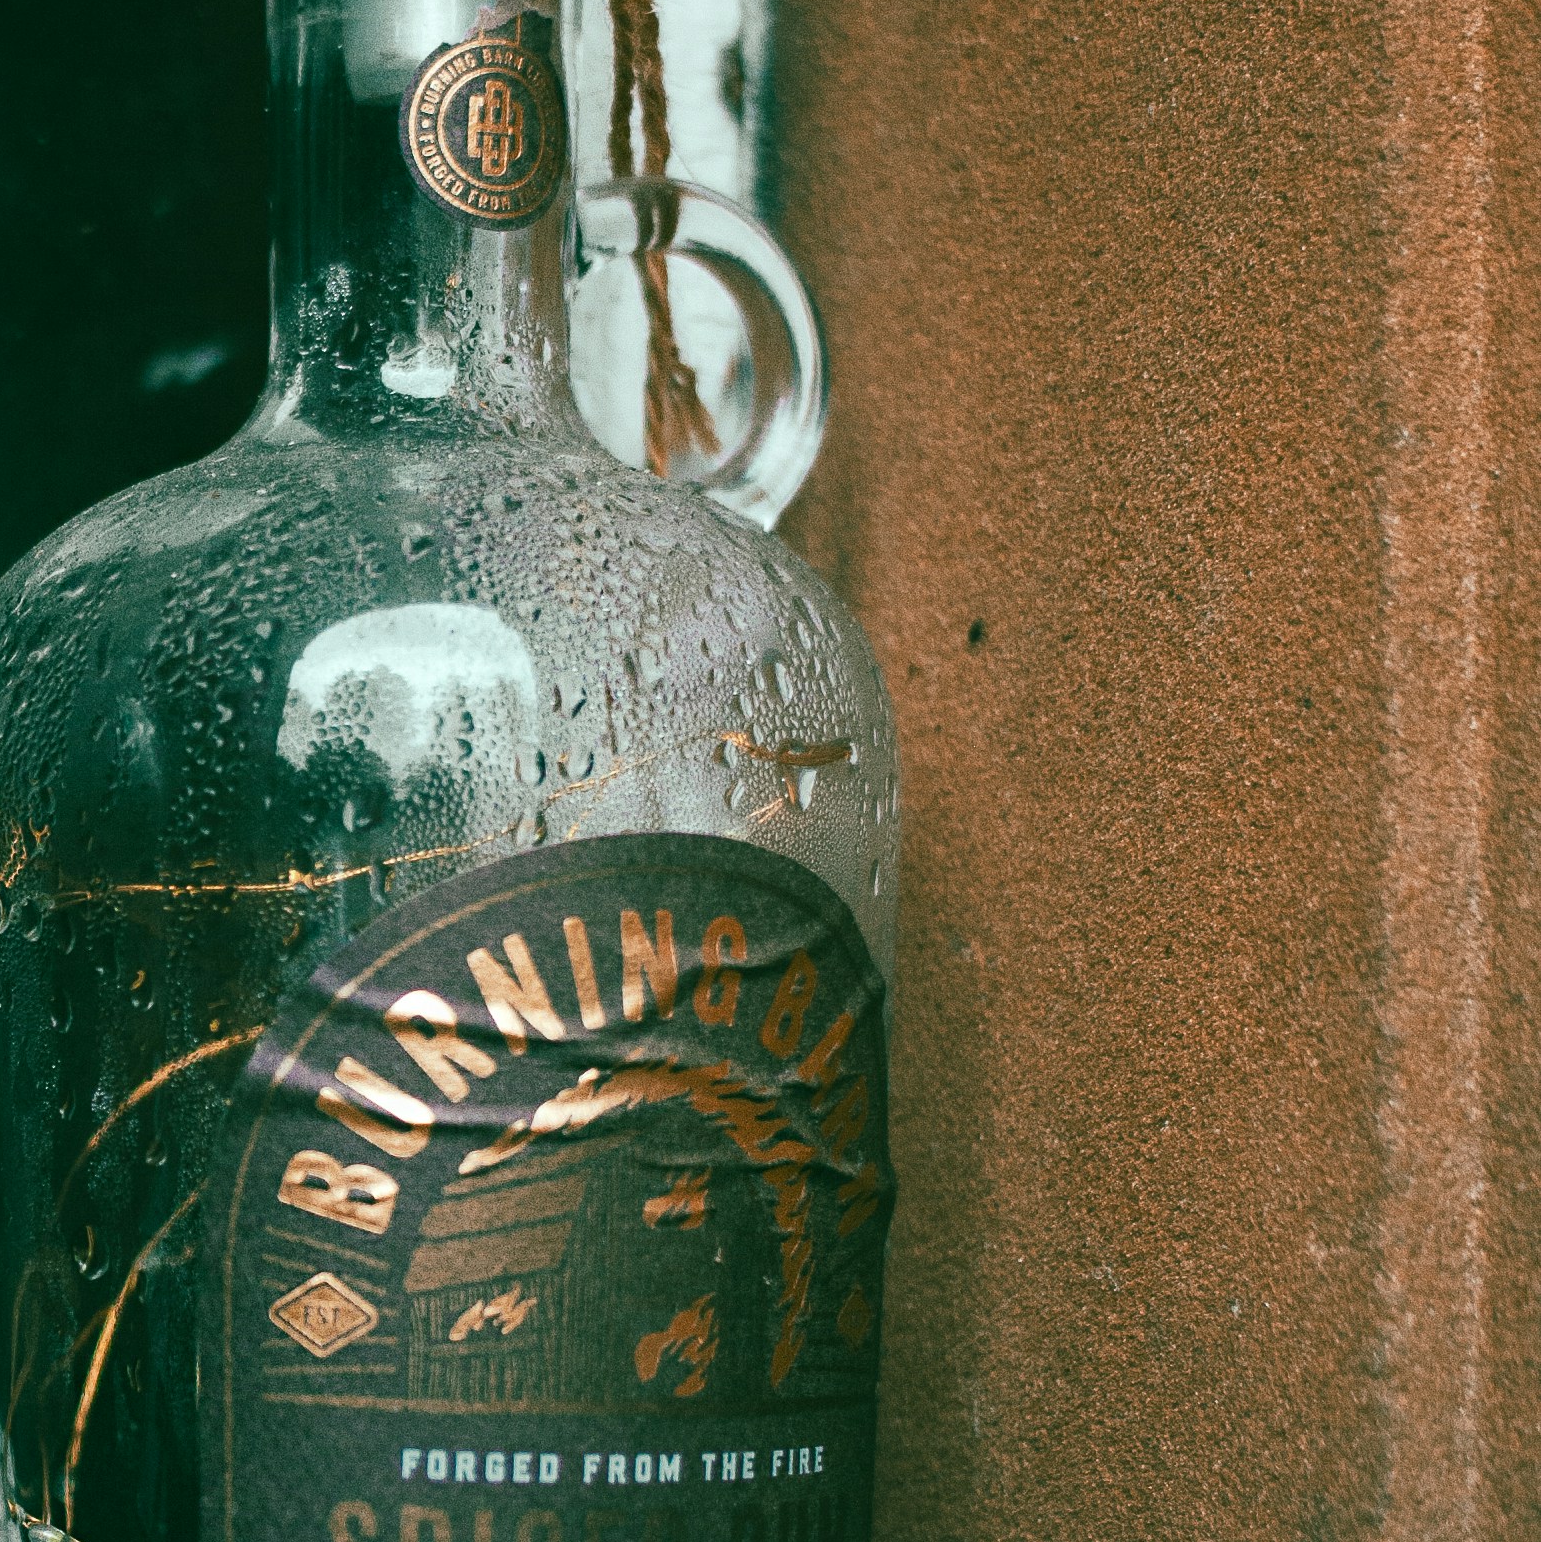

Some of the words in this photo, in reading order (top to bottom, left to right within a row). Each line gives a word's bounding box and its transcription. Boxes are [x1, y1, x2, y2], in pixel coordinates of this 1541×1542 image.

[420, 52, 477, 115] BURNING
[419, 132, 464, 197] FORGED
[278, 909, 748, 1235] BURNING
[400, 1447, 560, 1484] FORGED
[583, 1452, 681, 1484] FROM
[701, 1450, 756, 1482] THE
[772, 1445, 825, 1478] FIRE
